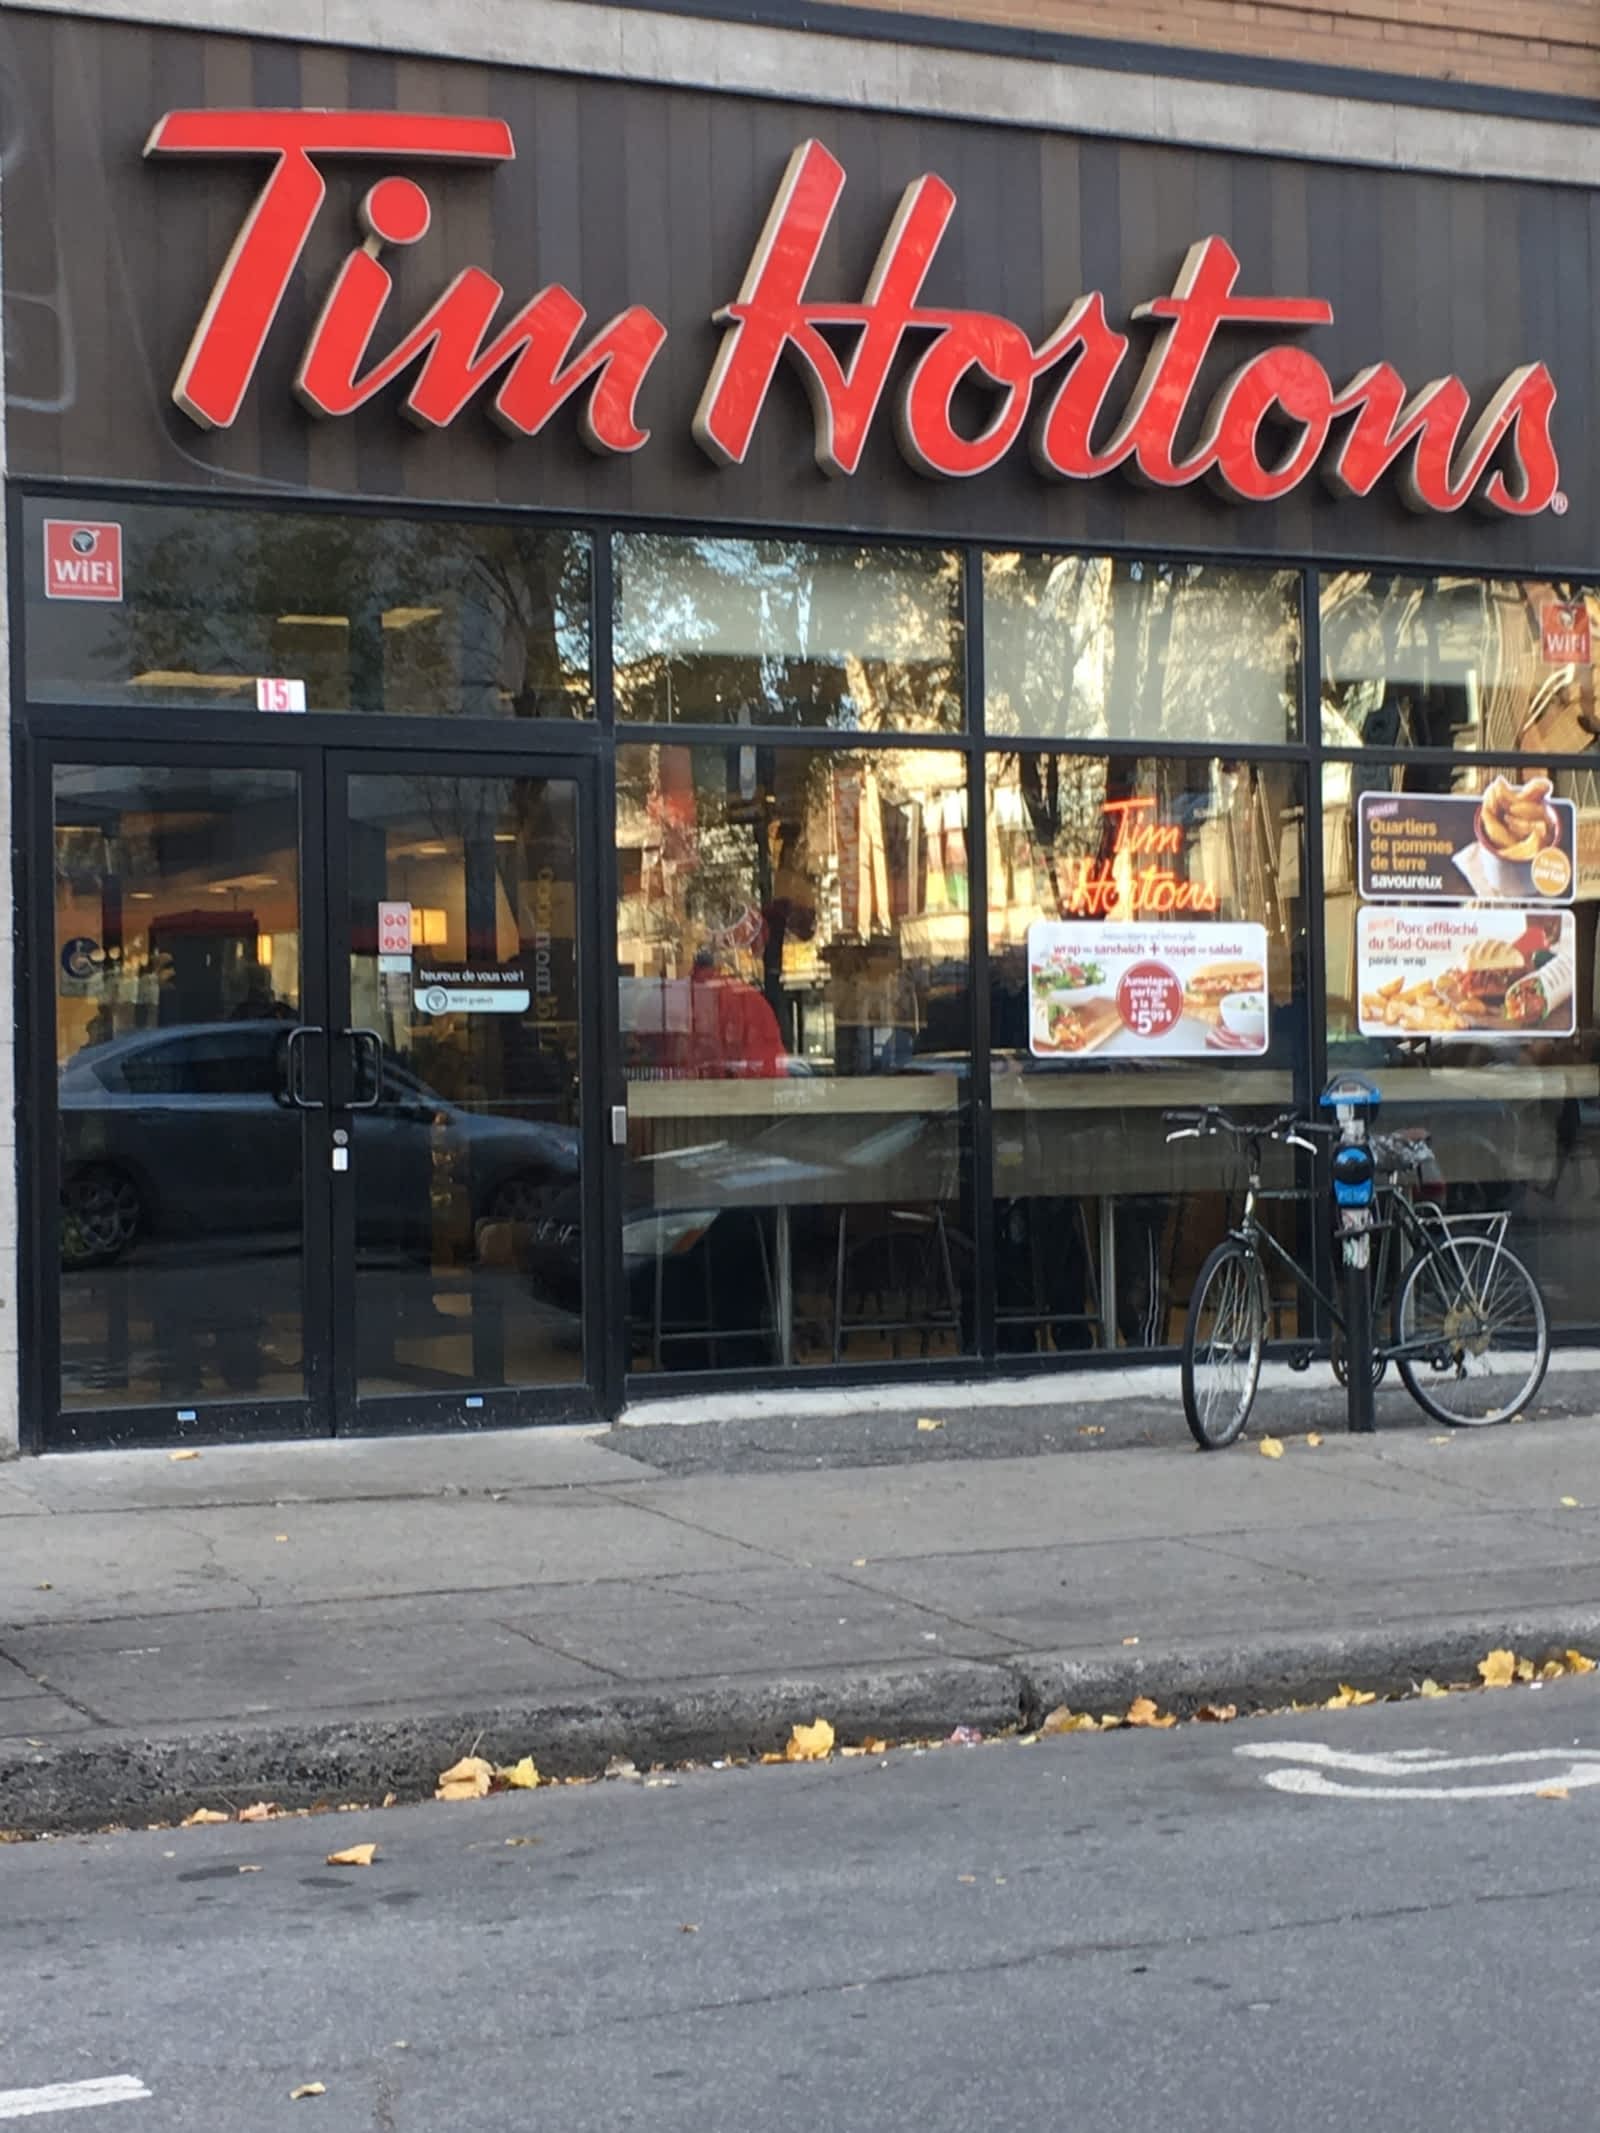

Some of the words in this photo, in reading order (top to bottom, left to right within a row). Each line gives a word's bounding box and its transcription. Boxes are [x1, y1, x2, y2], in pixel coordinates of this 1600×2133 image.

[145, 107, 668, 454] Tim
[693, 137, 1560, 517] Hortons
[54, 559, 113, 584] WiFi
[262, 678, 288, 711] 15
[1103, 797, 1180, 854] Tim
[1370, 817, 1437, 836] Quartiers
[1371, 837, 1389, 853] de
[1392, 840, 1453, 858] pommes
[1371, 855, 1389, 872] de
[1392, 857, 1427, 872] terre
[1069, 855, 1218, 914] Hortons
[1371, 874, 1443, 889] savoureux
[1397, 920, 1423, 935] Porc
[1427, 921, 1479, 936] effiloché
[1094, 944, 1145, 955] sandwich
[1368, 937, 1384, 950] du
[420, 969, 461, 981] heureux
[462, 969, 475, 981] de
[477, 971, 500, 981] vous
